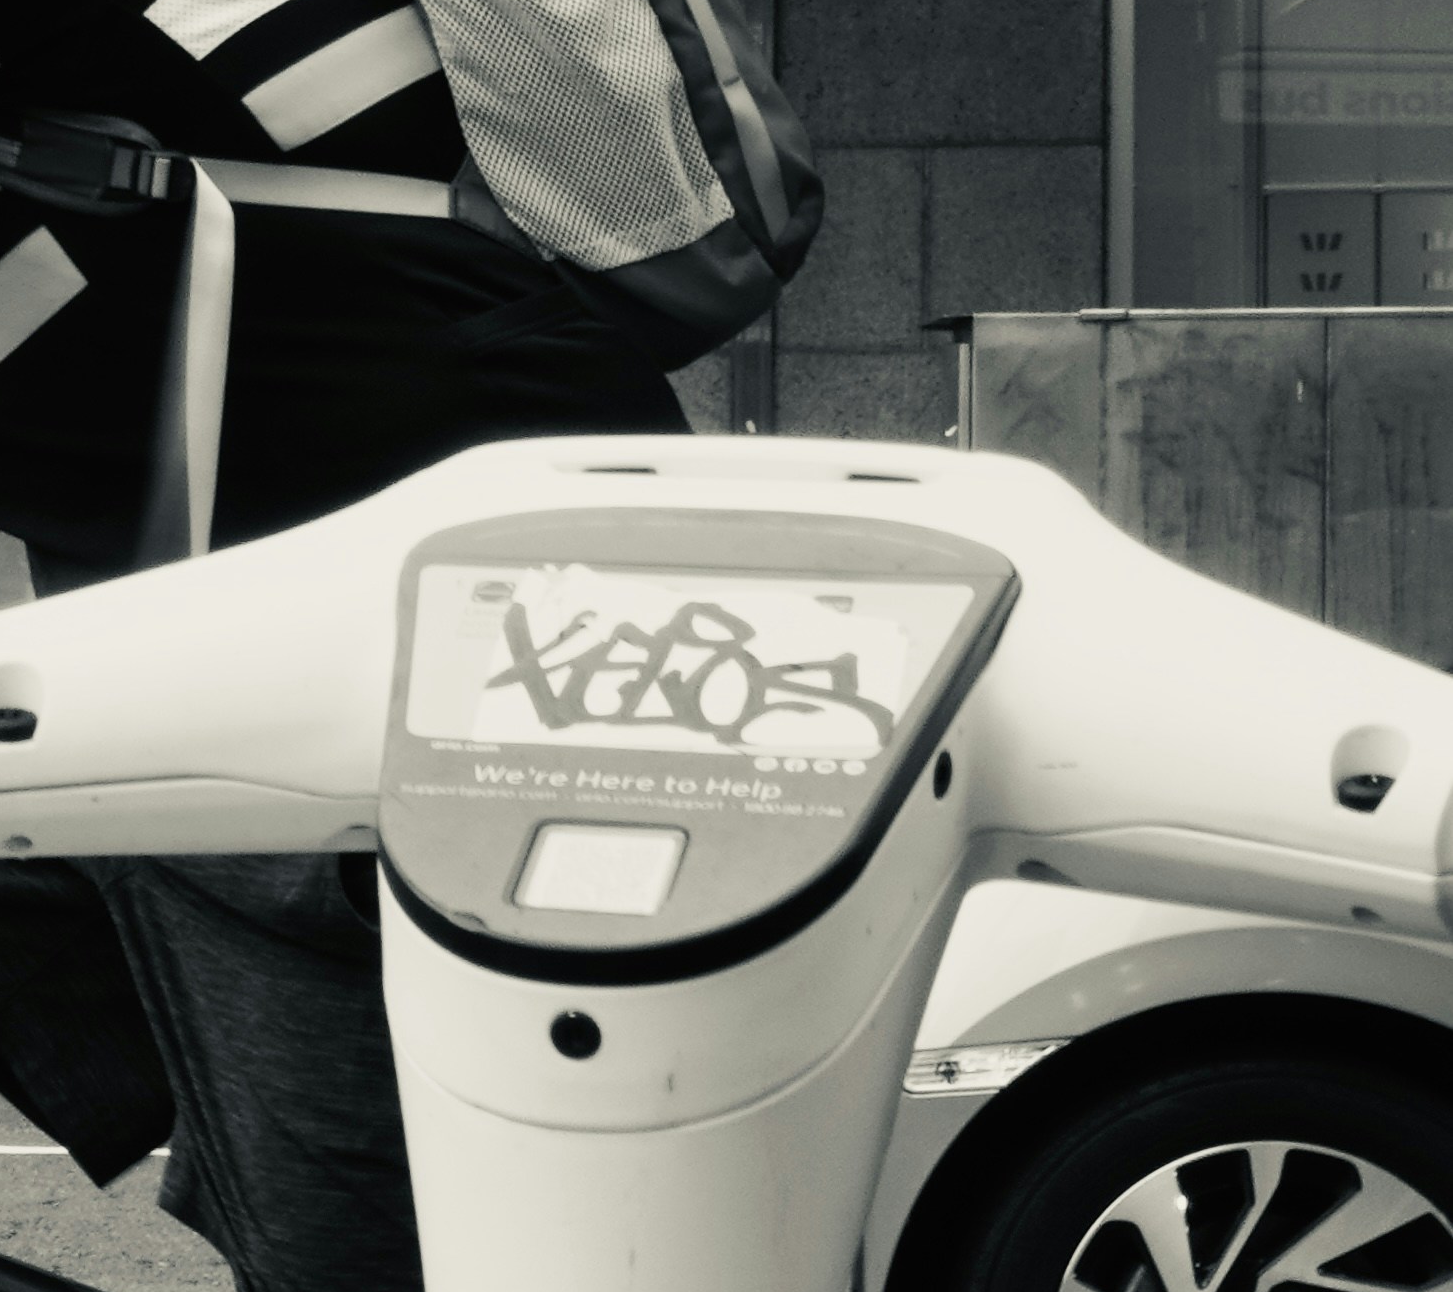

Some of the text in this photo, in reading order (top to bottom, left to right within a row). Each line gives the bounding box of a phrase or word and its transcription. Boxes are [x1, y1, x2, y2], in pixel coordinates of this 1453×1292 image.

[474, 763, 783, 803] We're Here to Help
